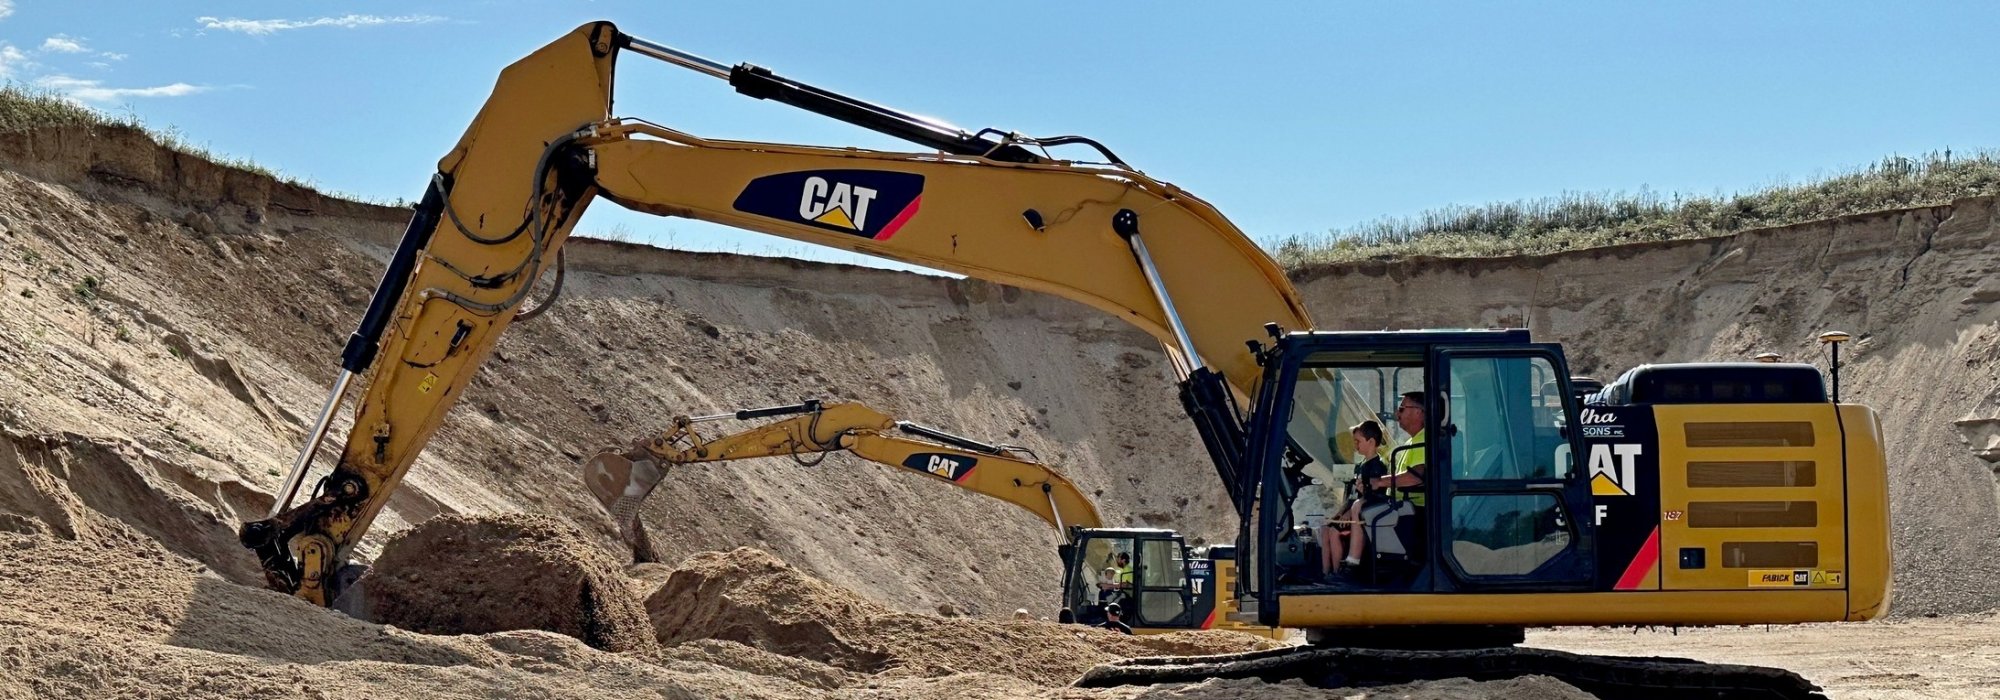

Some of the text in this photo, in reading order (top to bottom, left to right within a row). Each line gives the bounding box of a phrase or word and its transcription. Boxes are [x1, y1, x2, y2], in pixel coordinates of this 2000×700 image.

[799, 176, 878, 231] CAT
[1580, 408, 1617, 425] lha
[1583, 427, 1610, 436] SONS
[927, 455, 959, 480] CAT
[1794, 573, 1807, 582] CAT
